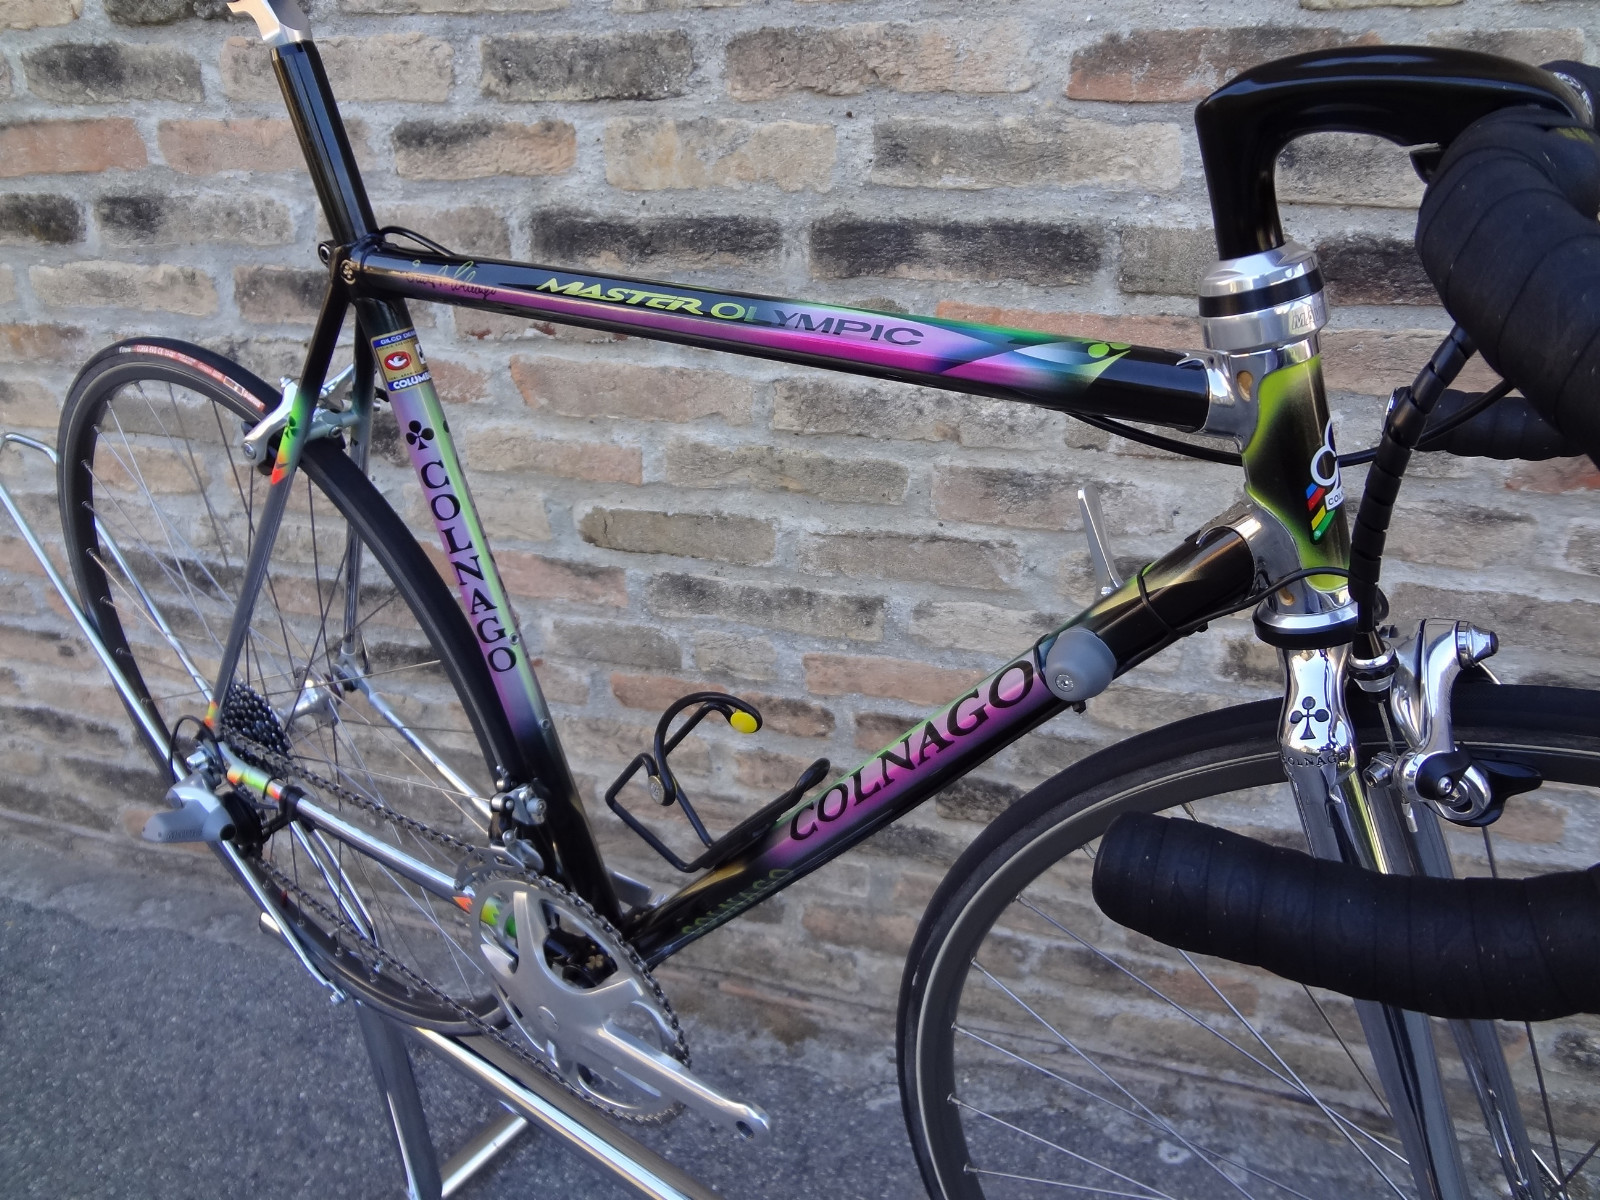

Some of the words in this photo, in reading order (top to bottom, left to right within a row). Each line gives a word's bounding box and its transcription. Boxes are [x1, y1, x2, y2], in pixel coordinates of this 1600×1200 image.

[536, 277, 703, 315] MASTER
[710, 302, 924, 346] OLYMPIC
[420, 460, 517, 673] COLNAGO
[790, 660, 1034, 840] COLNAGO
